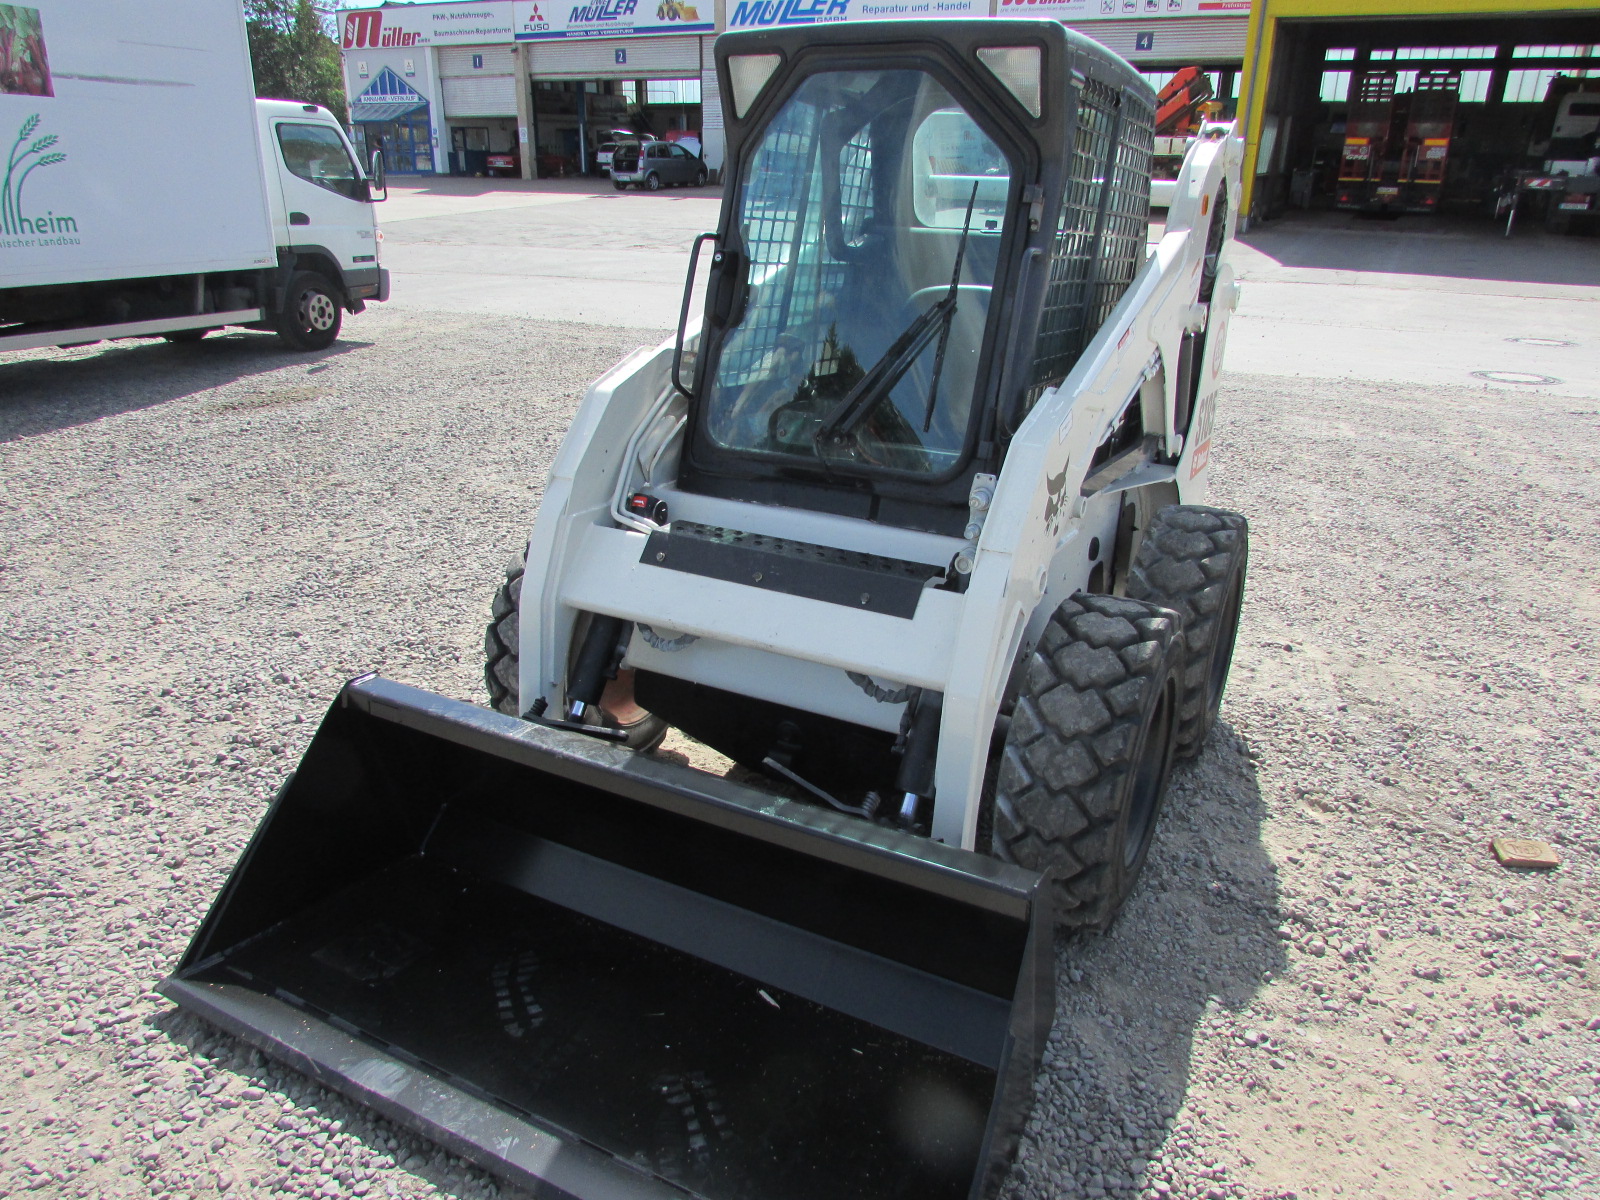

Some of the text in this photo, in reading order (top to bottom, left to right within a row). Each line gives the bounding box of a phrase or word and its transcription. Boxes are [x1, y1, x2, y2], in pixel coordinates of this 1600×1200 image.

[862, 1, 971, 15] Reparatur und -Handel
[343, 11, 421, 48] Müller
[524, 23, 550, 32] FUSO
[1141, 35, 1149, 48] 4
[617, 51, 624, 62] 2
[38, 237, 81, 247] Landbau
